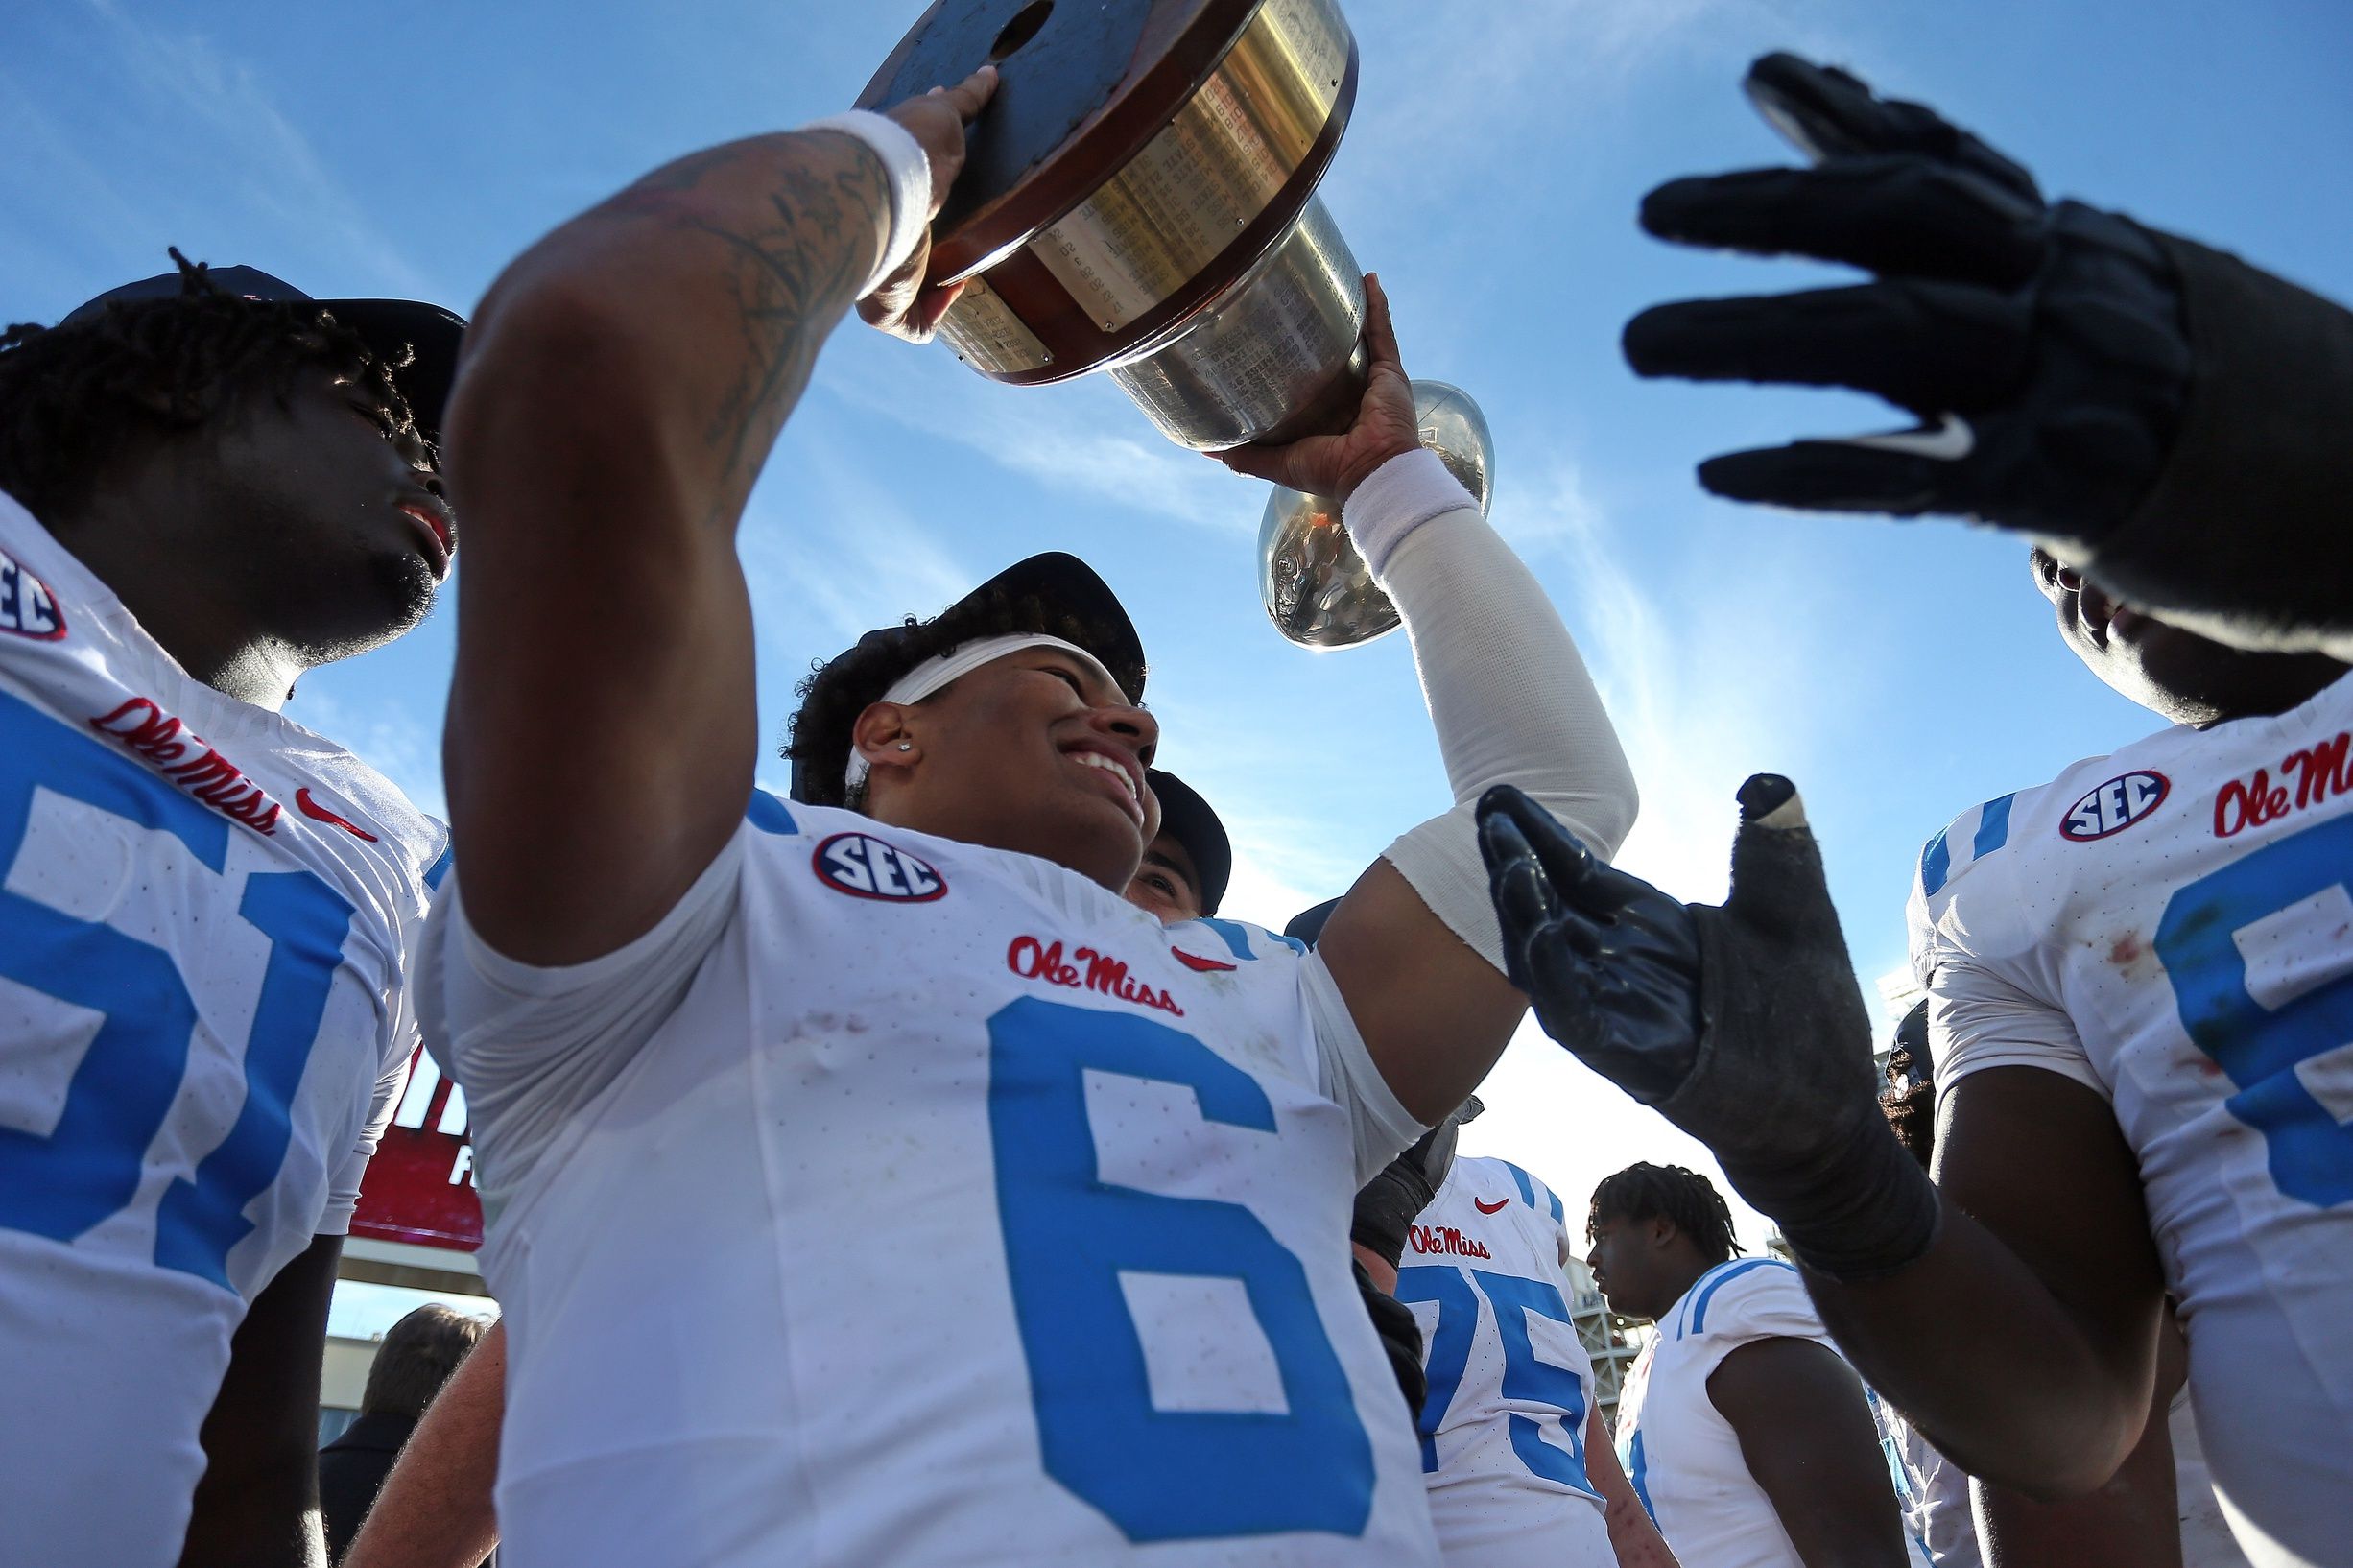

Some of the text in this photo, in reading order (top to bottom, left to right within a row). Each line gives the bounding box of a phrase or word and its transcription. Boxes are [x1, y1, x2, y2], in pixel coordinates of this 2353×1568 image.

[89, 697, 282, 837] Ole Miss
[2066, 773, 2159, 836] SEC
[2214, 768, 2291, 838] Ole
[823, 834, 940, 898] SEC
[1007, 935, 1185, 1017] Ole Miss
[986, 994, 1378, 1546] 6
[1410, 1224, 1491, 1259] Ole Miss
[1393, 1265, 1605, 1501] 75
